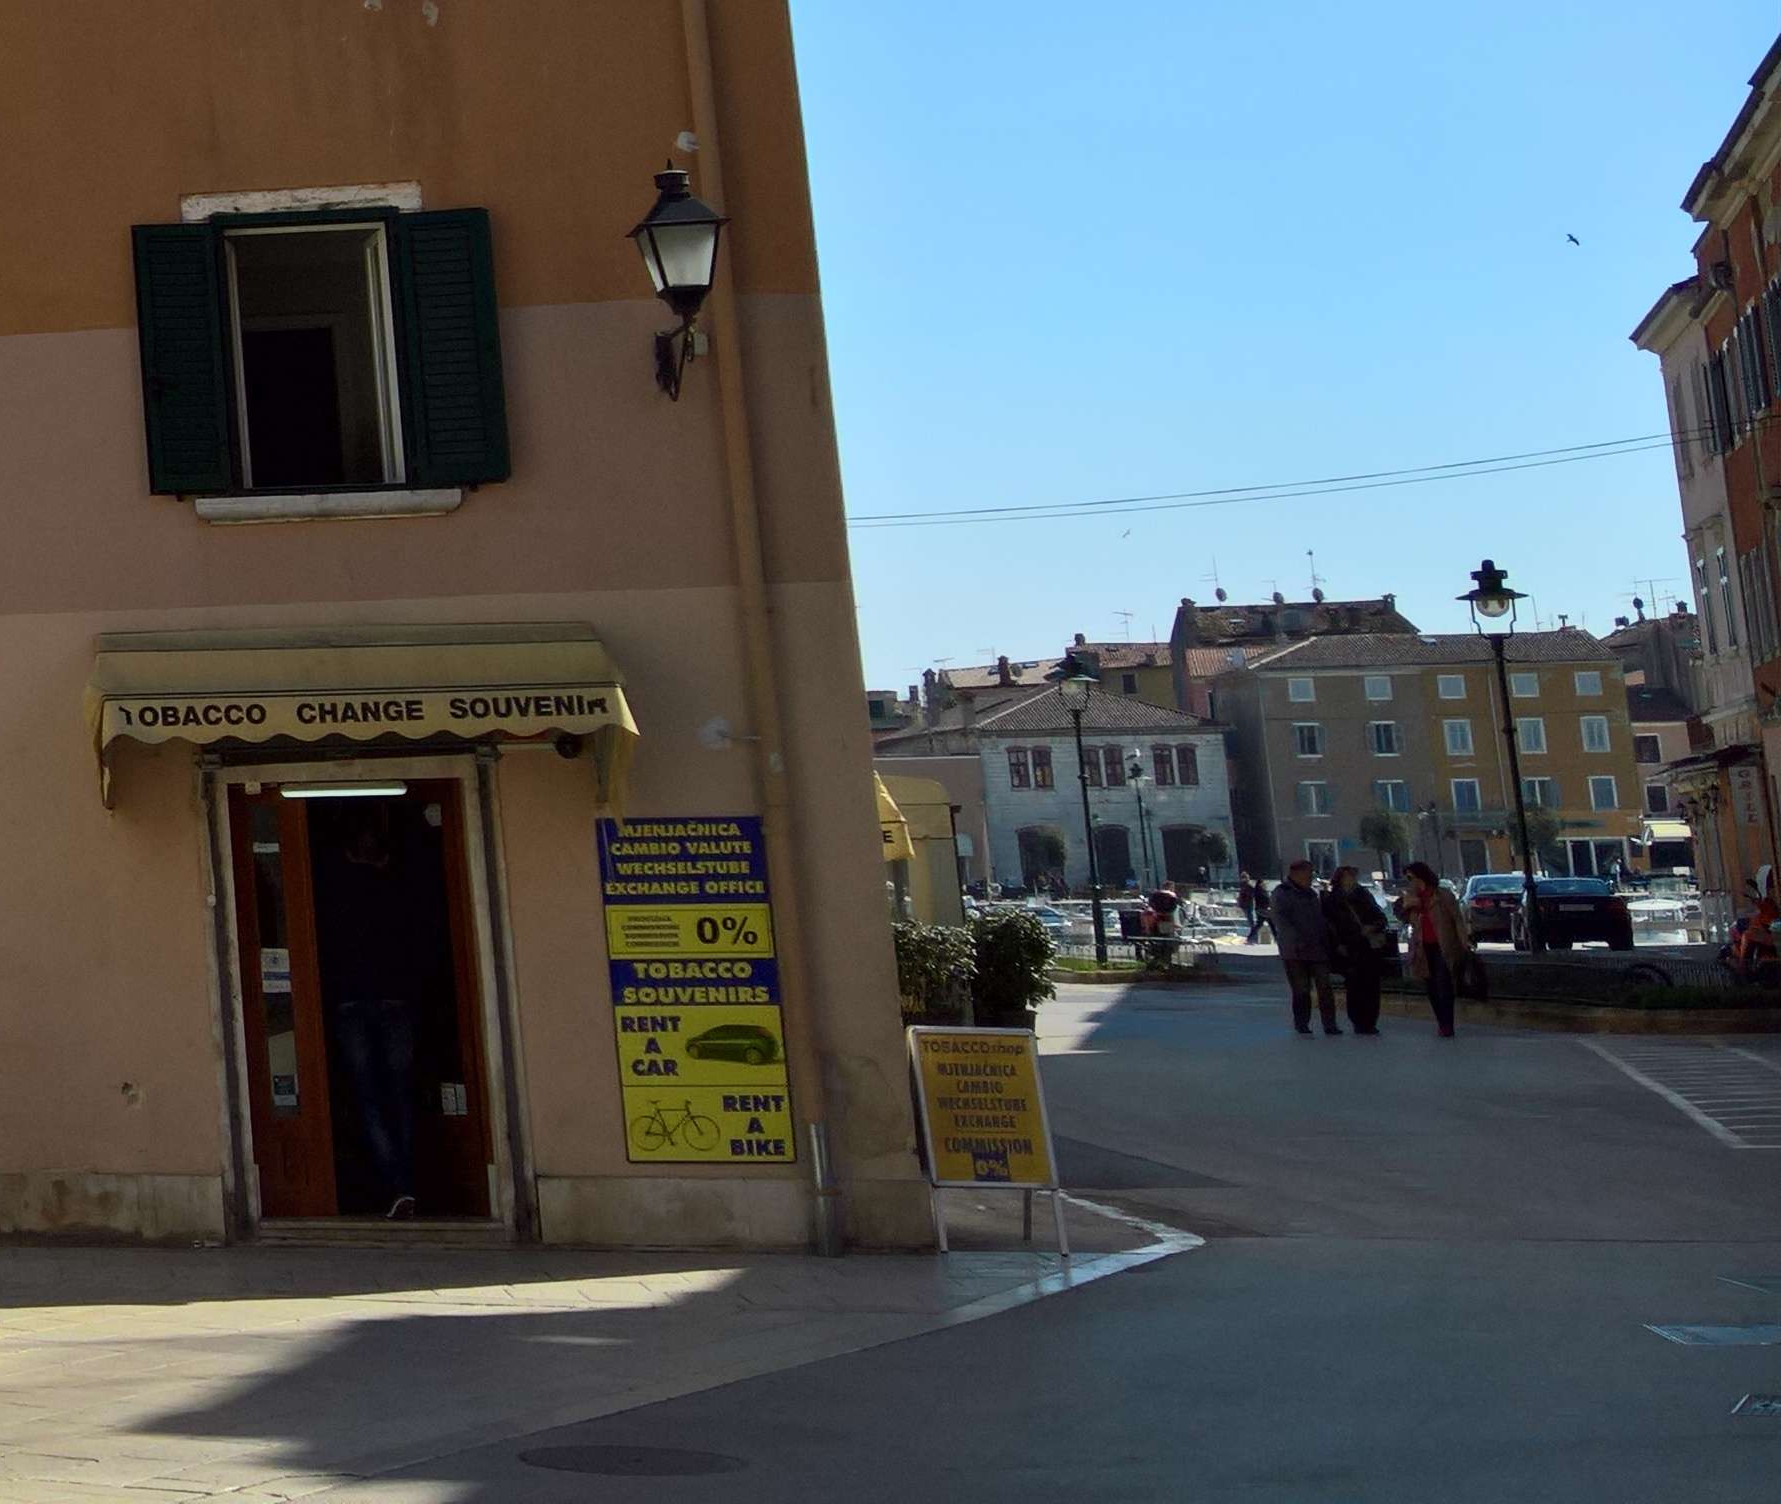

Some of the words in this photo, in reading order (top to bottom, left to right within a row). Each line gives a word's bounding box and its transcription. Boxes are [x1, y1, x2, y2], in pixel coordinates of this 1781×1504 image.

[295, 699, 425, 724] CHANGE
[611, 841, 682, 856] CAMBIO
[685, 840, 753, 856] VALUTE
[615, 860, 751, 876] WECHSELSTUBE
[605, 880, 700, 896] EXCHANGE
[704, 879, 766, 895] OFFICE
[696, 915, 759, 945] 0%
[633, 961, 753, 980] TOBACCO
[622, 985, 770, 1004] SOUVENIRS
[620, 1015, 681, 1033] RENT
[644, 1037, 662, 1054] A
[631, 1059, 679, 1077] CAR
[723, 1094, 785, 1112] RENT
[747, 1117, 765, 1134] A
[730, 1138, 786, 1156] BIKE
[944, 1137, 1034, 1155] COMMISSION
